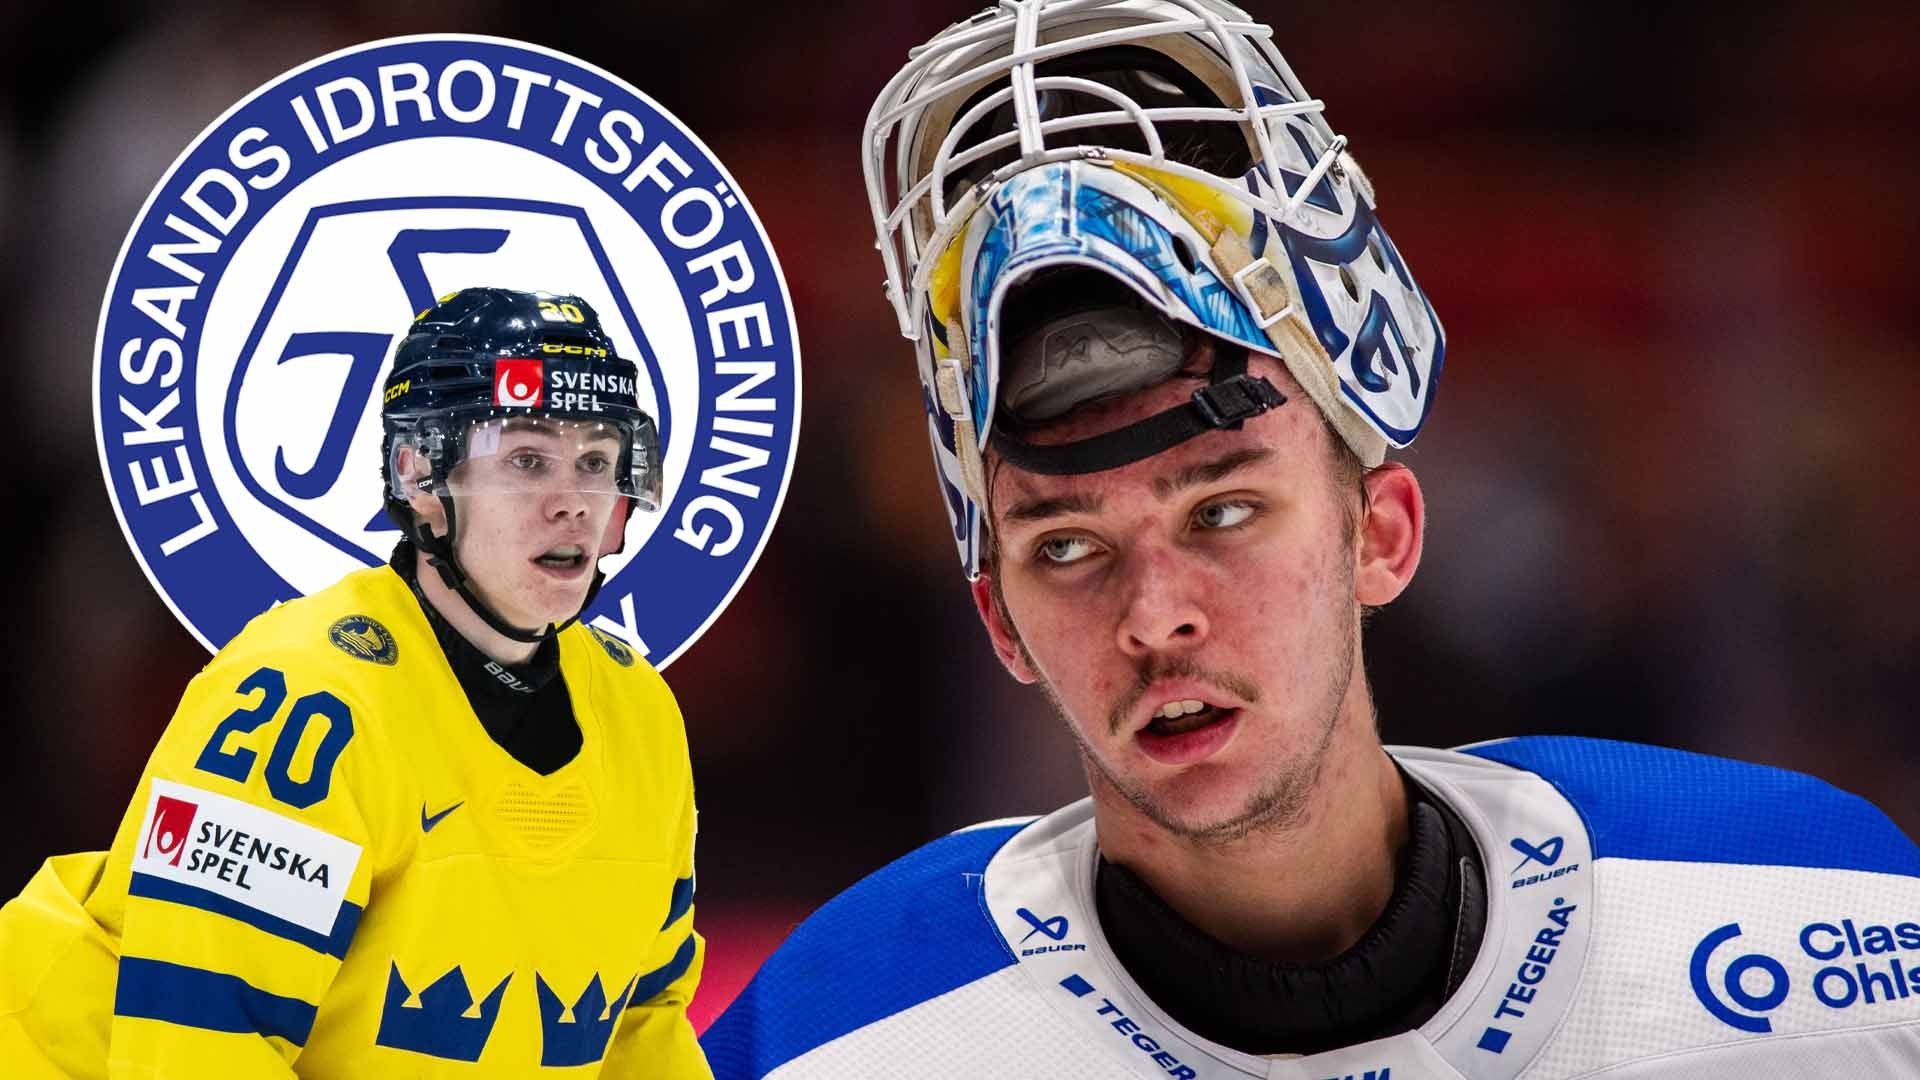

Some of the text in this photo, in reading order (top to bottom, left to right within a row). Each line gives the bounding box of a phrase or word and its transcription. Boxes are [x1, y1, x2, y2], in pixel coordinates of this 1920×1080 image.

[537, 302, 585, 324] 20
[542, 344, 607, 358] CCM
[384, 379, 411, 403] CCM
[551, 371, 635, 396] SVENSKA
[550, 392, 604, 412] SPEL
[194, 667, 354, 810] 20
[197, 820, 330, 889] SVENSKA
[186, 849, 252, 891] SPEL
[1511, 863, 1579, 889] BAUER
[1021, 943, 1087, 957] BAUER
[1798, 918, 1920, 961] Clas
